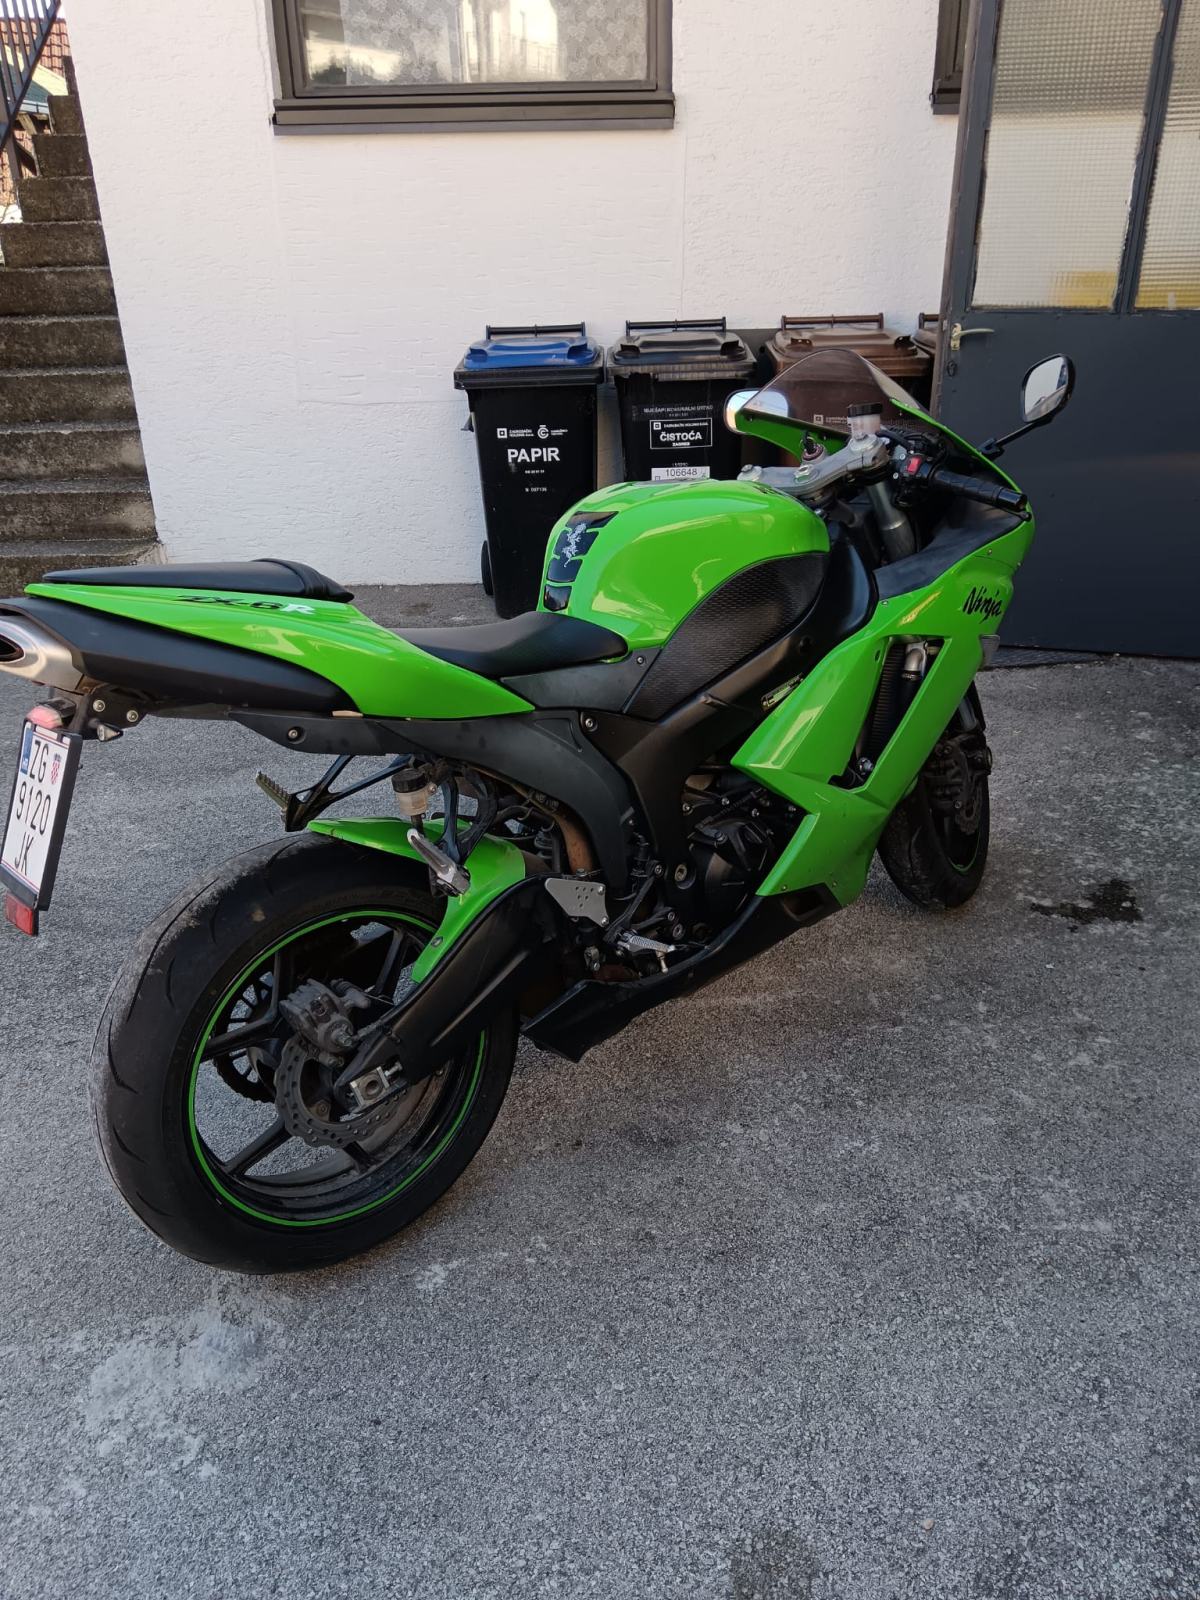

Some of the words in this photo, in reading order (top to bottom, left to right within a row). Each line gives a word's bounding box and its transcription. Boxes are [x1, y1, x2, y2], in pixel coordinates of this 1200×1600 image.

[660, 430, 702, 441] ČISTOĆA
[507, 447, 561, 463] PAPIR
[665, 468, 698, 477] 106648
[963, 586, 1003, 624] Ninja
[29, 740, 49, 783] ZG
[16, 781, 51, 836] 9120
[14, 831, 34, 876] JK
